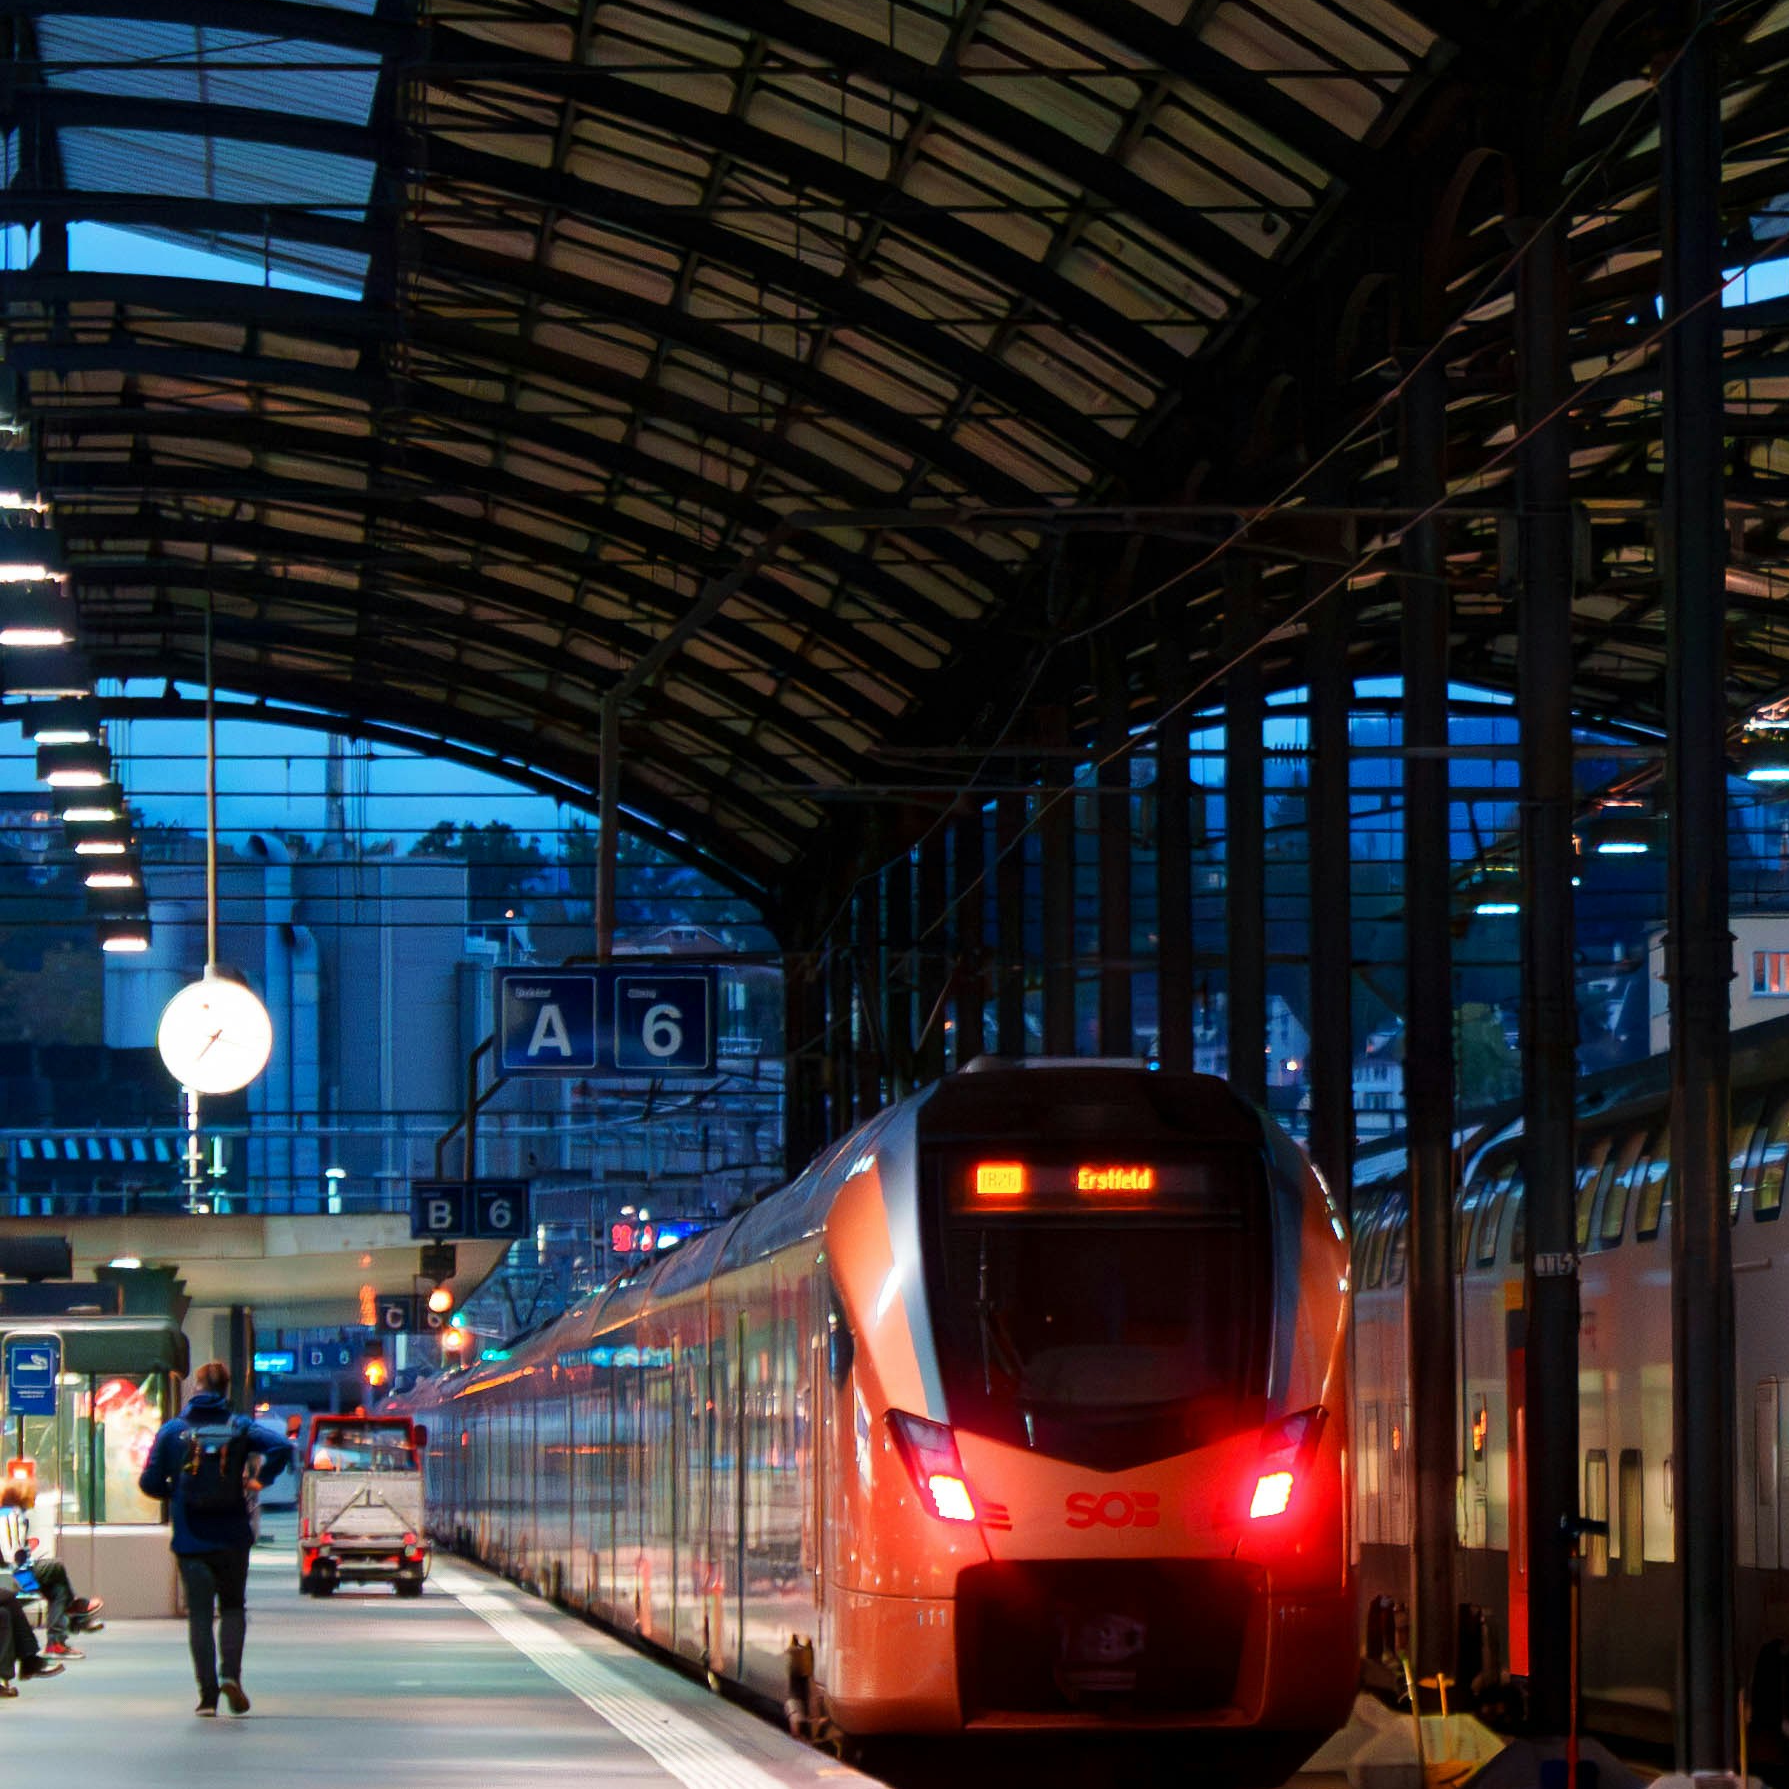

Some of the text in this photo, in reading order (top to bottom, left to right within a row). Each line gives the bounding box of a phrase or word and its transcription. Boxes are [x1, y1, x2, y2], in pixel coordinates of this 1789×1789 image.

[527, 1004, 573, 1057] A
[642, 1003, 683, 1057] 6
[1077, 1166, 1151, 1190] Erstfeld
[428, 1200, 452, 1229] B
[489, 1199, 512, 1229] 6
[386, 1307, 403, 1328] C
[1066, 1491, 1160, 1530] SOB
